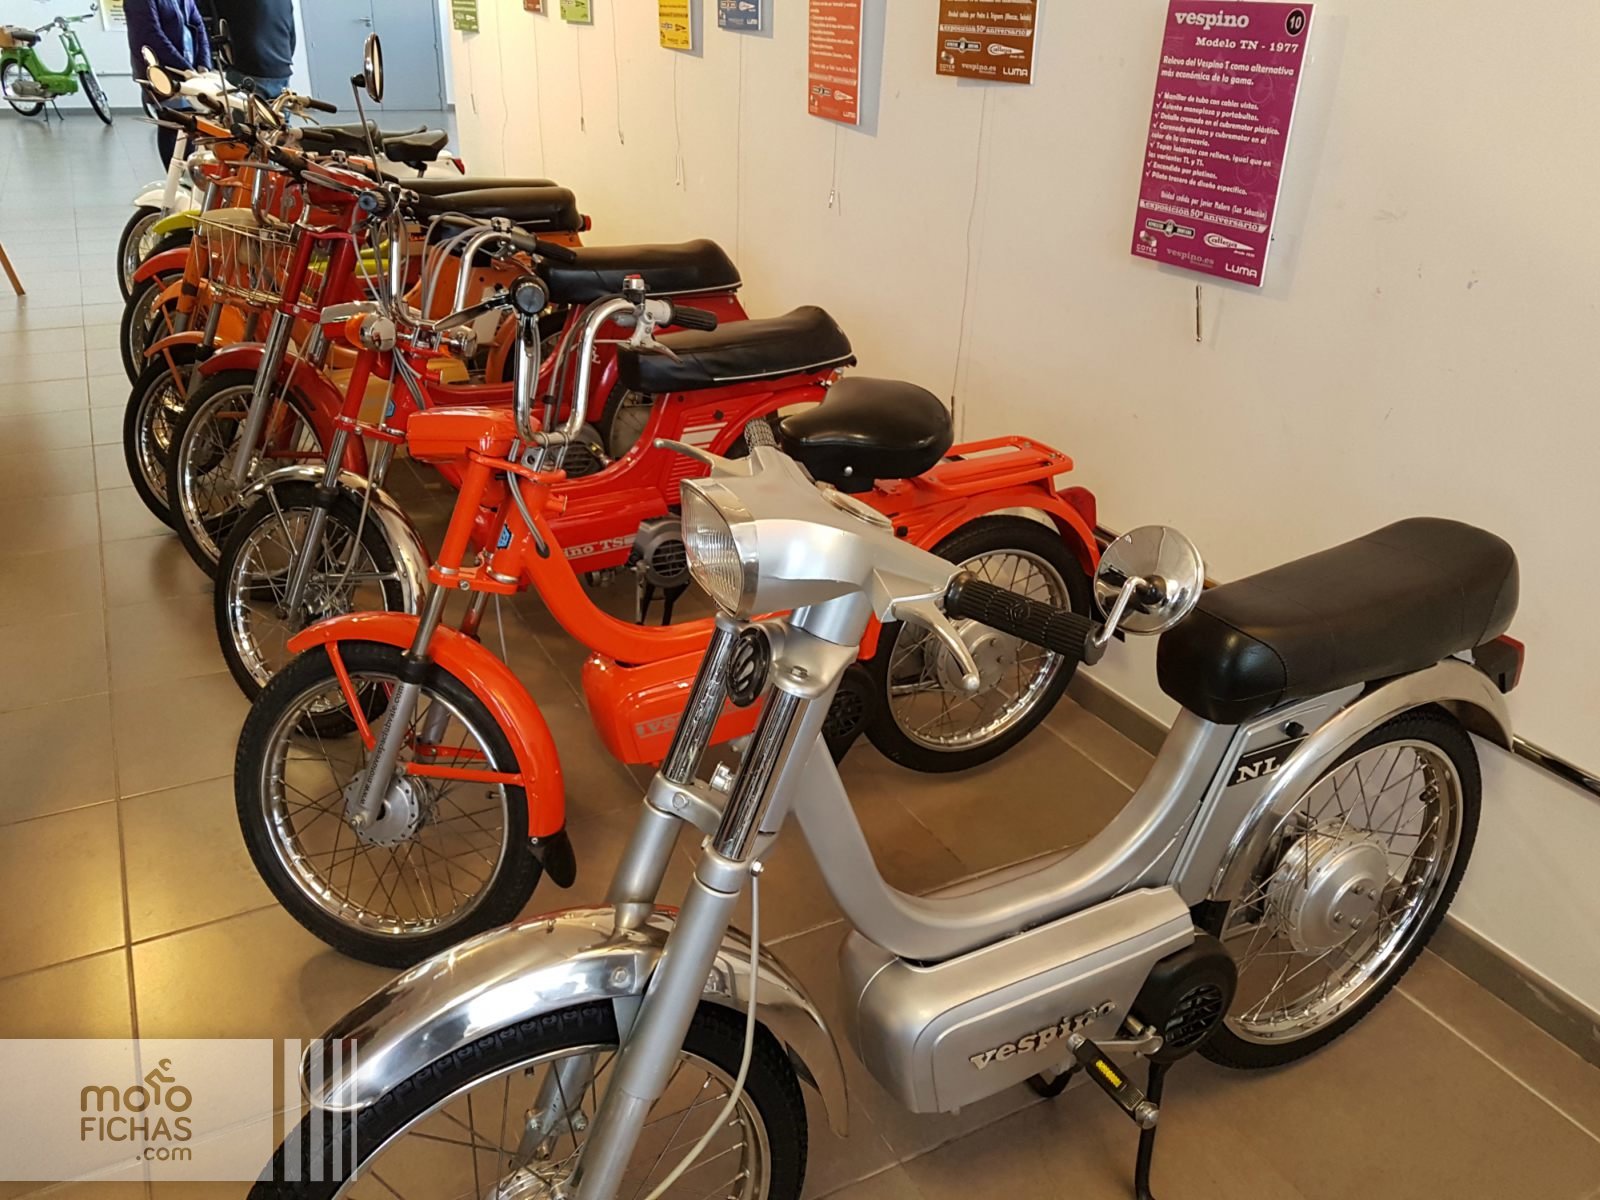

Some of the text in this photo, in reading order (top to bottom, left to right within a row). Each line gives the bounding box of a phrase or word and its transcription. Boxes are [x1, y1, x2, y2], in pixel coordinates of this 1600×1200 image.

[1175, 10, 1249, 30] vespino
[1290, 17, 1301, 29] 10
[1195, 37, 1236, 48] Modelo
[1240, 40, 1259, 49] TN
[1270, 43, 1298, 52] 1977
[1003, 67, 1028, 76] LUMA
[1163, 56, 1184, 65] Relevo
[1186, 57, 1196, 66] del
[1198, 58, 1223, 70] Vespino
[1231, 64, 1249, 72] como
[1251, 64, 1294, 76] alternativa
[1161, 68, 1254, 85] más económica de la gama.
[1220, 120, 1253, 131] cubremotor
[1215, 131, 1250, 142] cubremotor
[1157, 153, 1182, 162] variantes
[1173, 144, 1197, 155] laterales
[1232, 154, 1249, 163] igual
[1153, 162, 1180, 172] Encendido
[1182, 167, 1192, 175] por
[1169, 175, 1187, 184] trasero
[1197, 179, 1216, 189] diseño
[1146, 201, 1189, 216] exposición
[1204, 212, 1258, 231] aniversario
[1225, 263, 1257, 278] LUMA
[600, 537, 624, 551] TS
[1236, 757, 1280, 783] NL
[969, 1000, 1116, 1070] vespino
